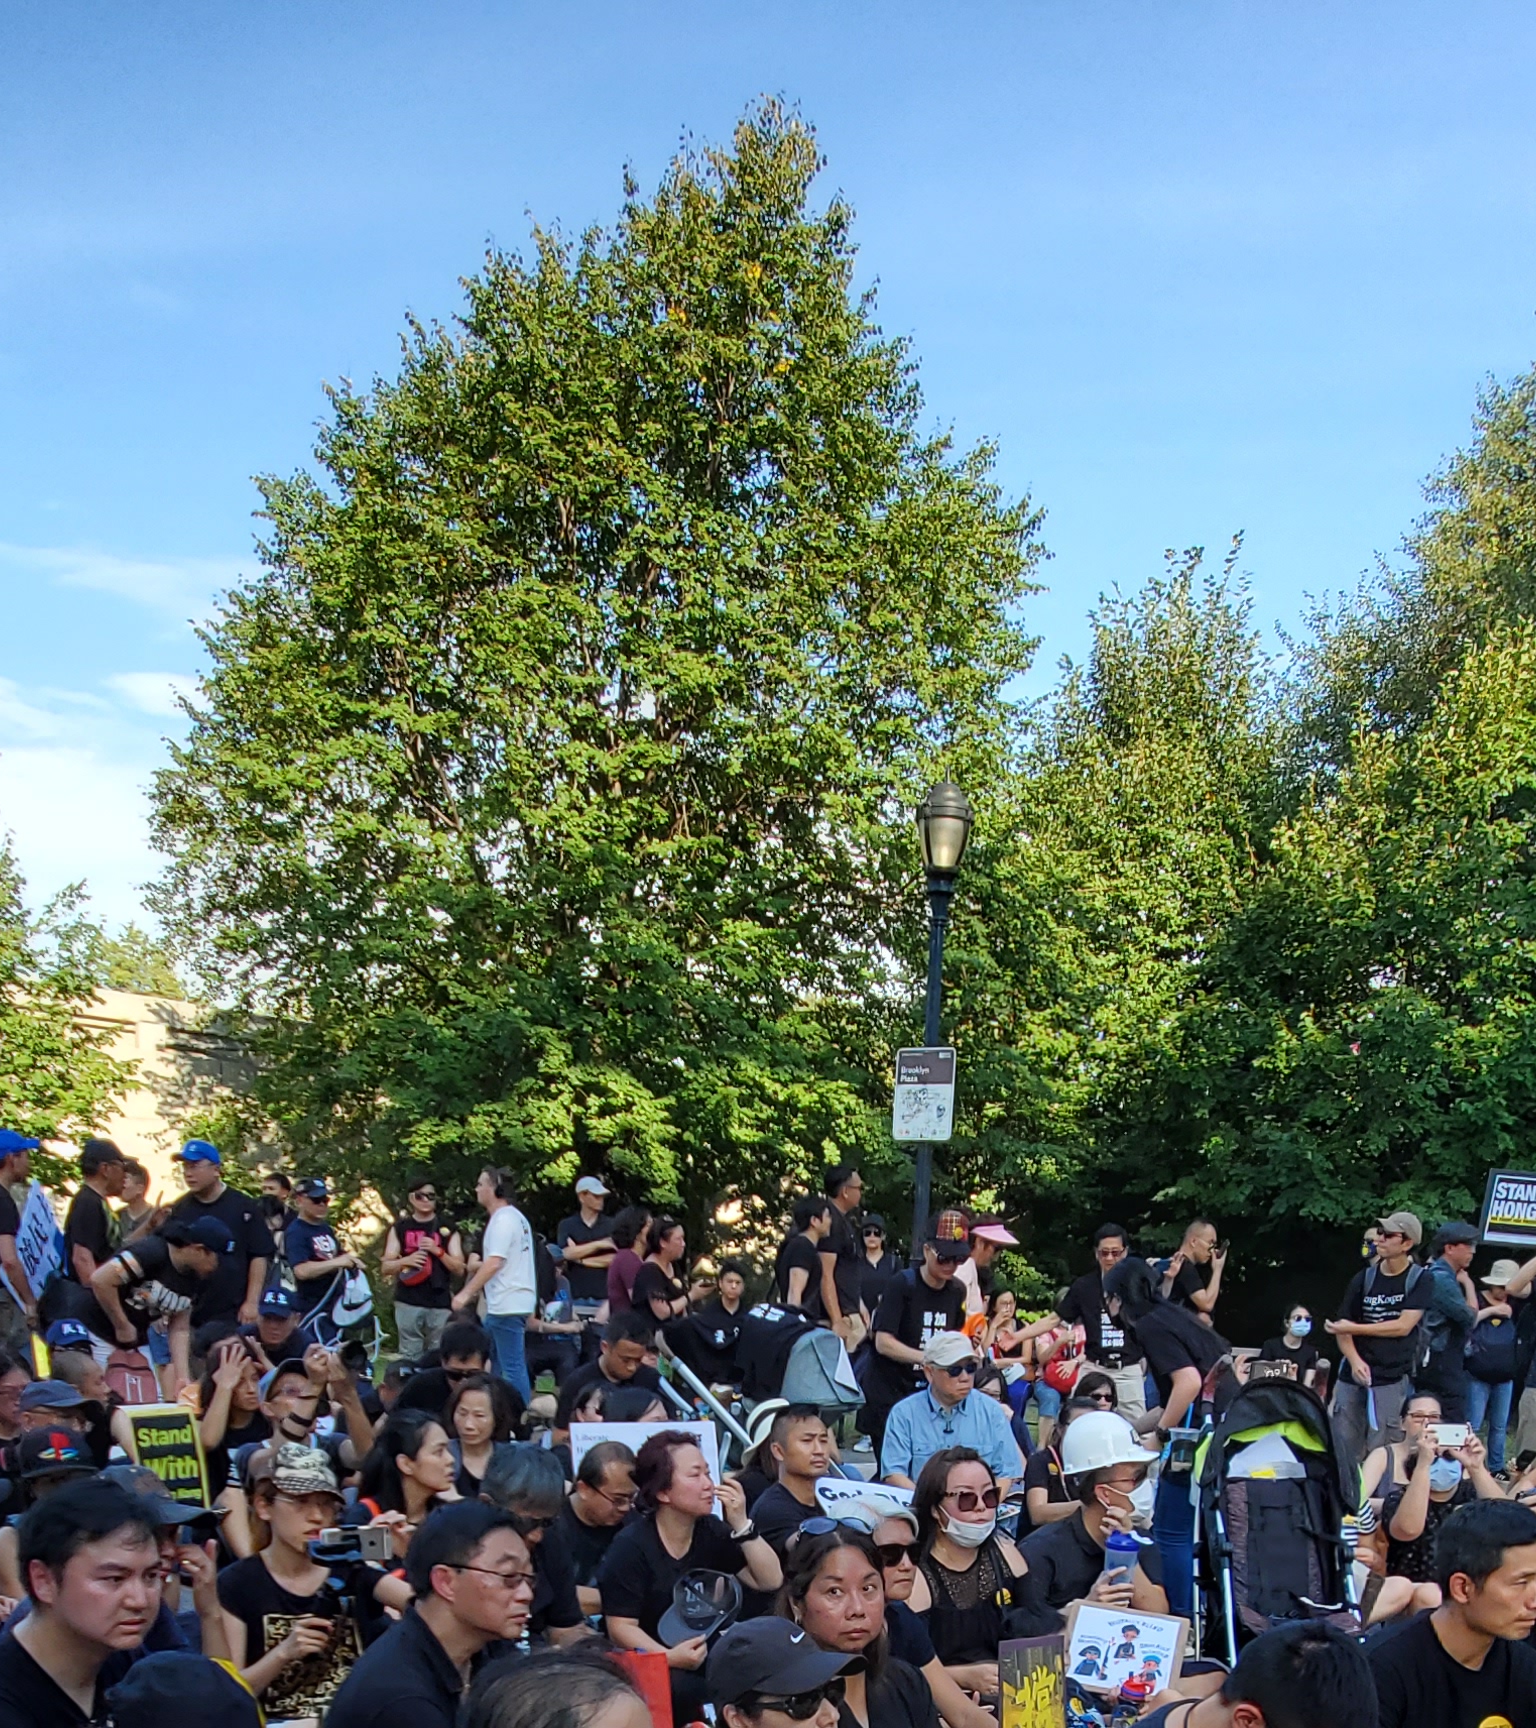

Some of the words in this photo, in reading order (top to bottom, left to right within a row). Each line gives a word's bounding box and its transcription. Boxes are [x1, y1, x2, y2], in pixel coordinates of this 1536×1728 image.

[901, 1066, 930, 1075] Brooklyn
[1363, 1294, 1405, 1308] ongKonger
[138, 1424, 193, 1448] Stand
[143, 1455, 199, 1480] With
